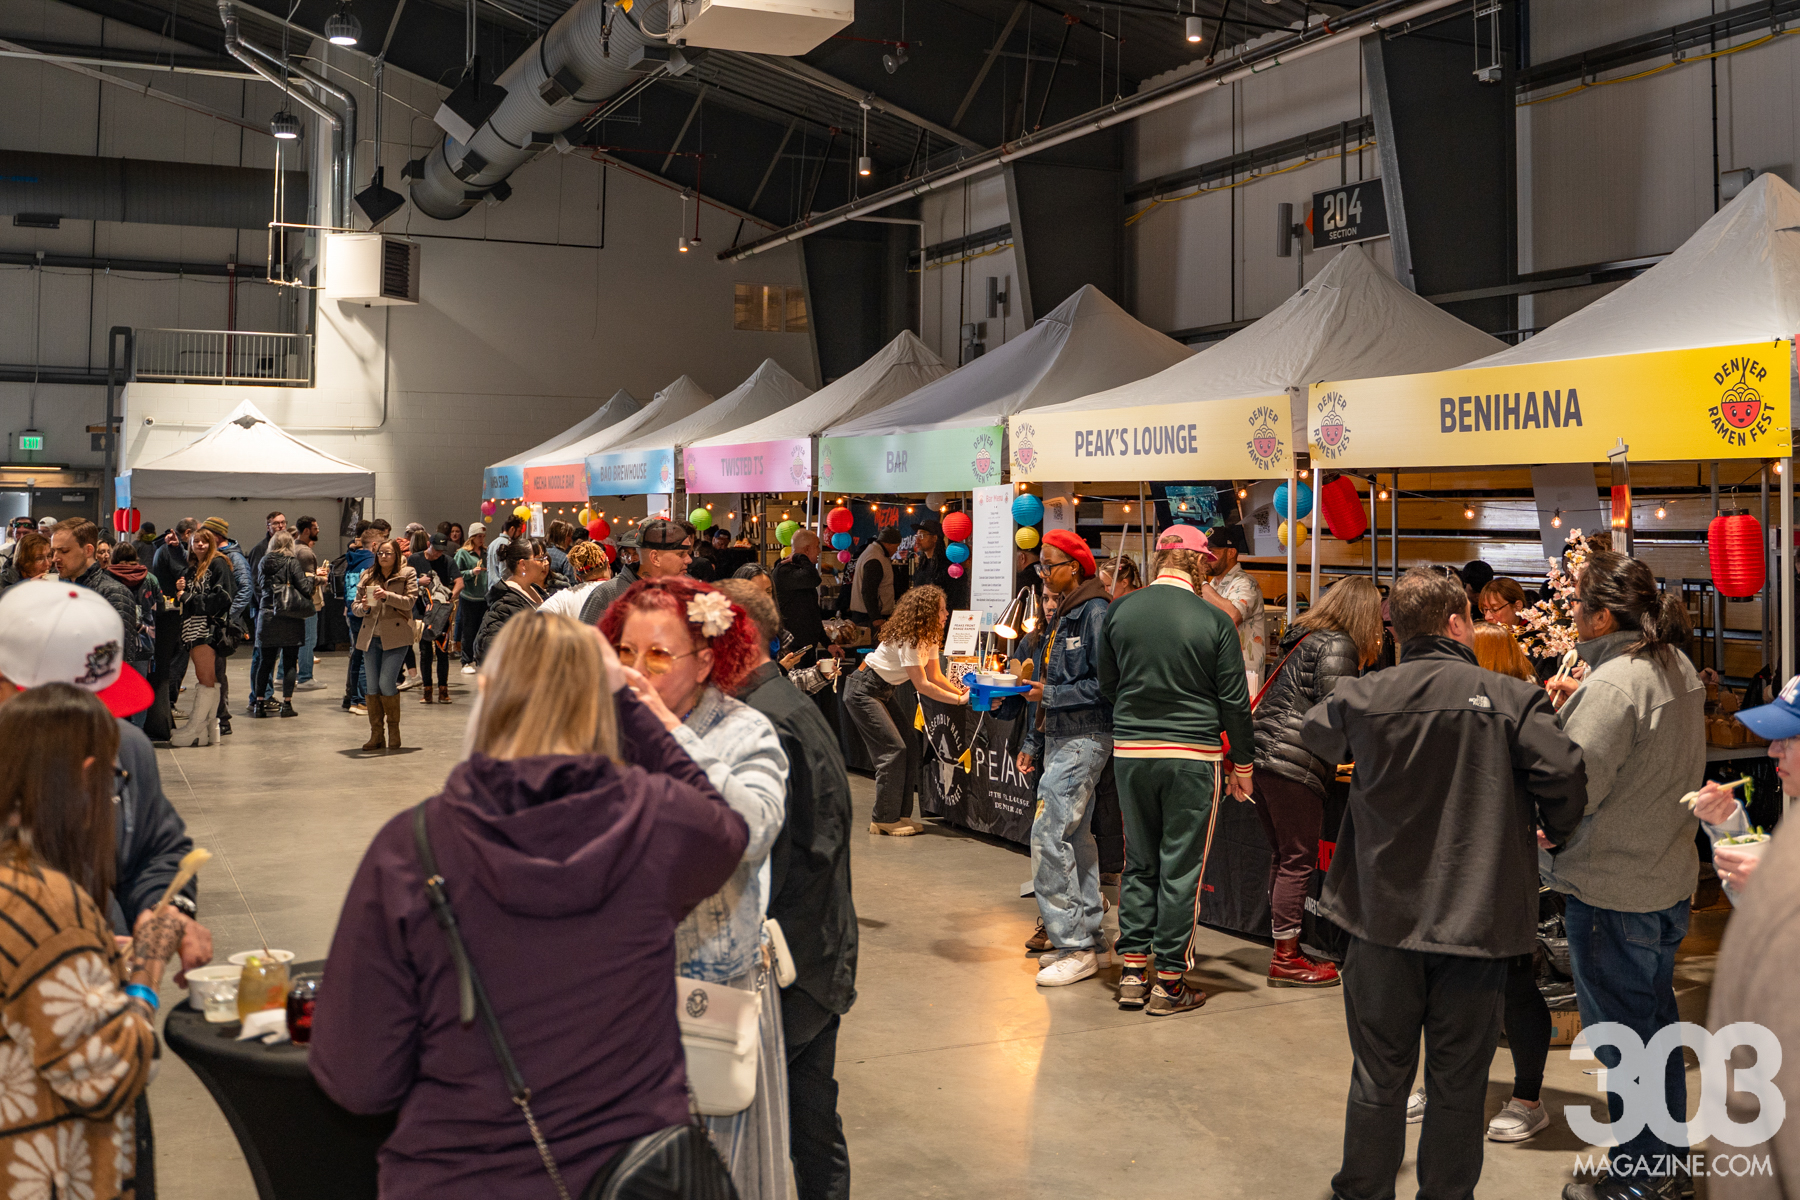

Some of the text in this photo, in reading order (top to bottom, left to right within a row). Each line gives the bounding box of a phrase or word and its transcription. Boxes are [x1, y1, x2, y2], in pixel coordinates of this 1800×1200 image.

[1323, 188, 1362, 231] 204
[1328, 227, 1357, 240] SECTION
[1713, 357, 1767, 386] DENVER
[1317, 391, 1347, 413] DENVER
[1440, 388, 1583, 434] BENIHANA
[1248, 405, 1279, 427] DENVER
[1708, 402, 1775, 446] RAMEN FEST
[973, 433, 994, 450] DENVER
[1015, 422, 1035, 439] DENVER
[1075, 423, 1198, 457] PEAK'S LOUNGE
[23, 437, 40, 449] EXIT
[1246, 439, 1284, 471] RAMEN FEST
[1313, 427, 1352, 460] RAMEN FEST
[600, 466, 612, 482] BAO
[613, 462, 647, 481] BREWHOUSE
[721, 455, 764, 476] TWISTED T'S
[886, 450, 908, 474] BAR
[1013, 449, 1038, 475] RAMEN FEST
[565, 474, 575, 489] BAR
[950, 722, 963, 752] HALL
